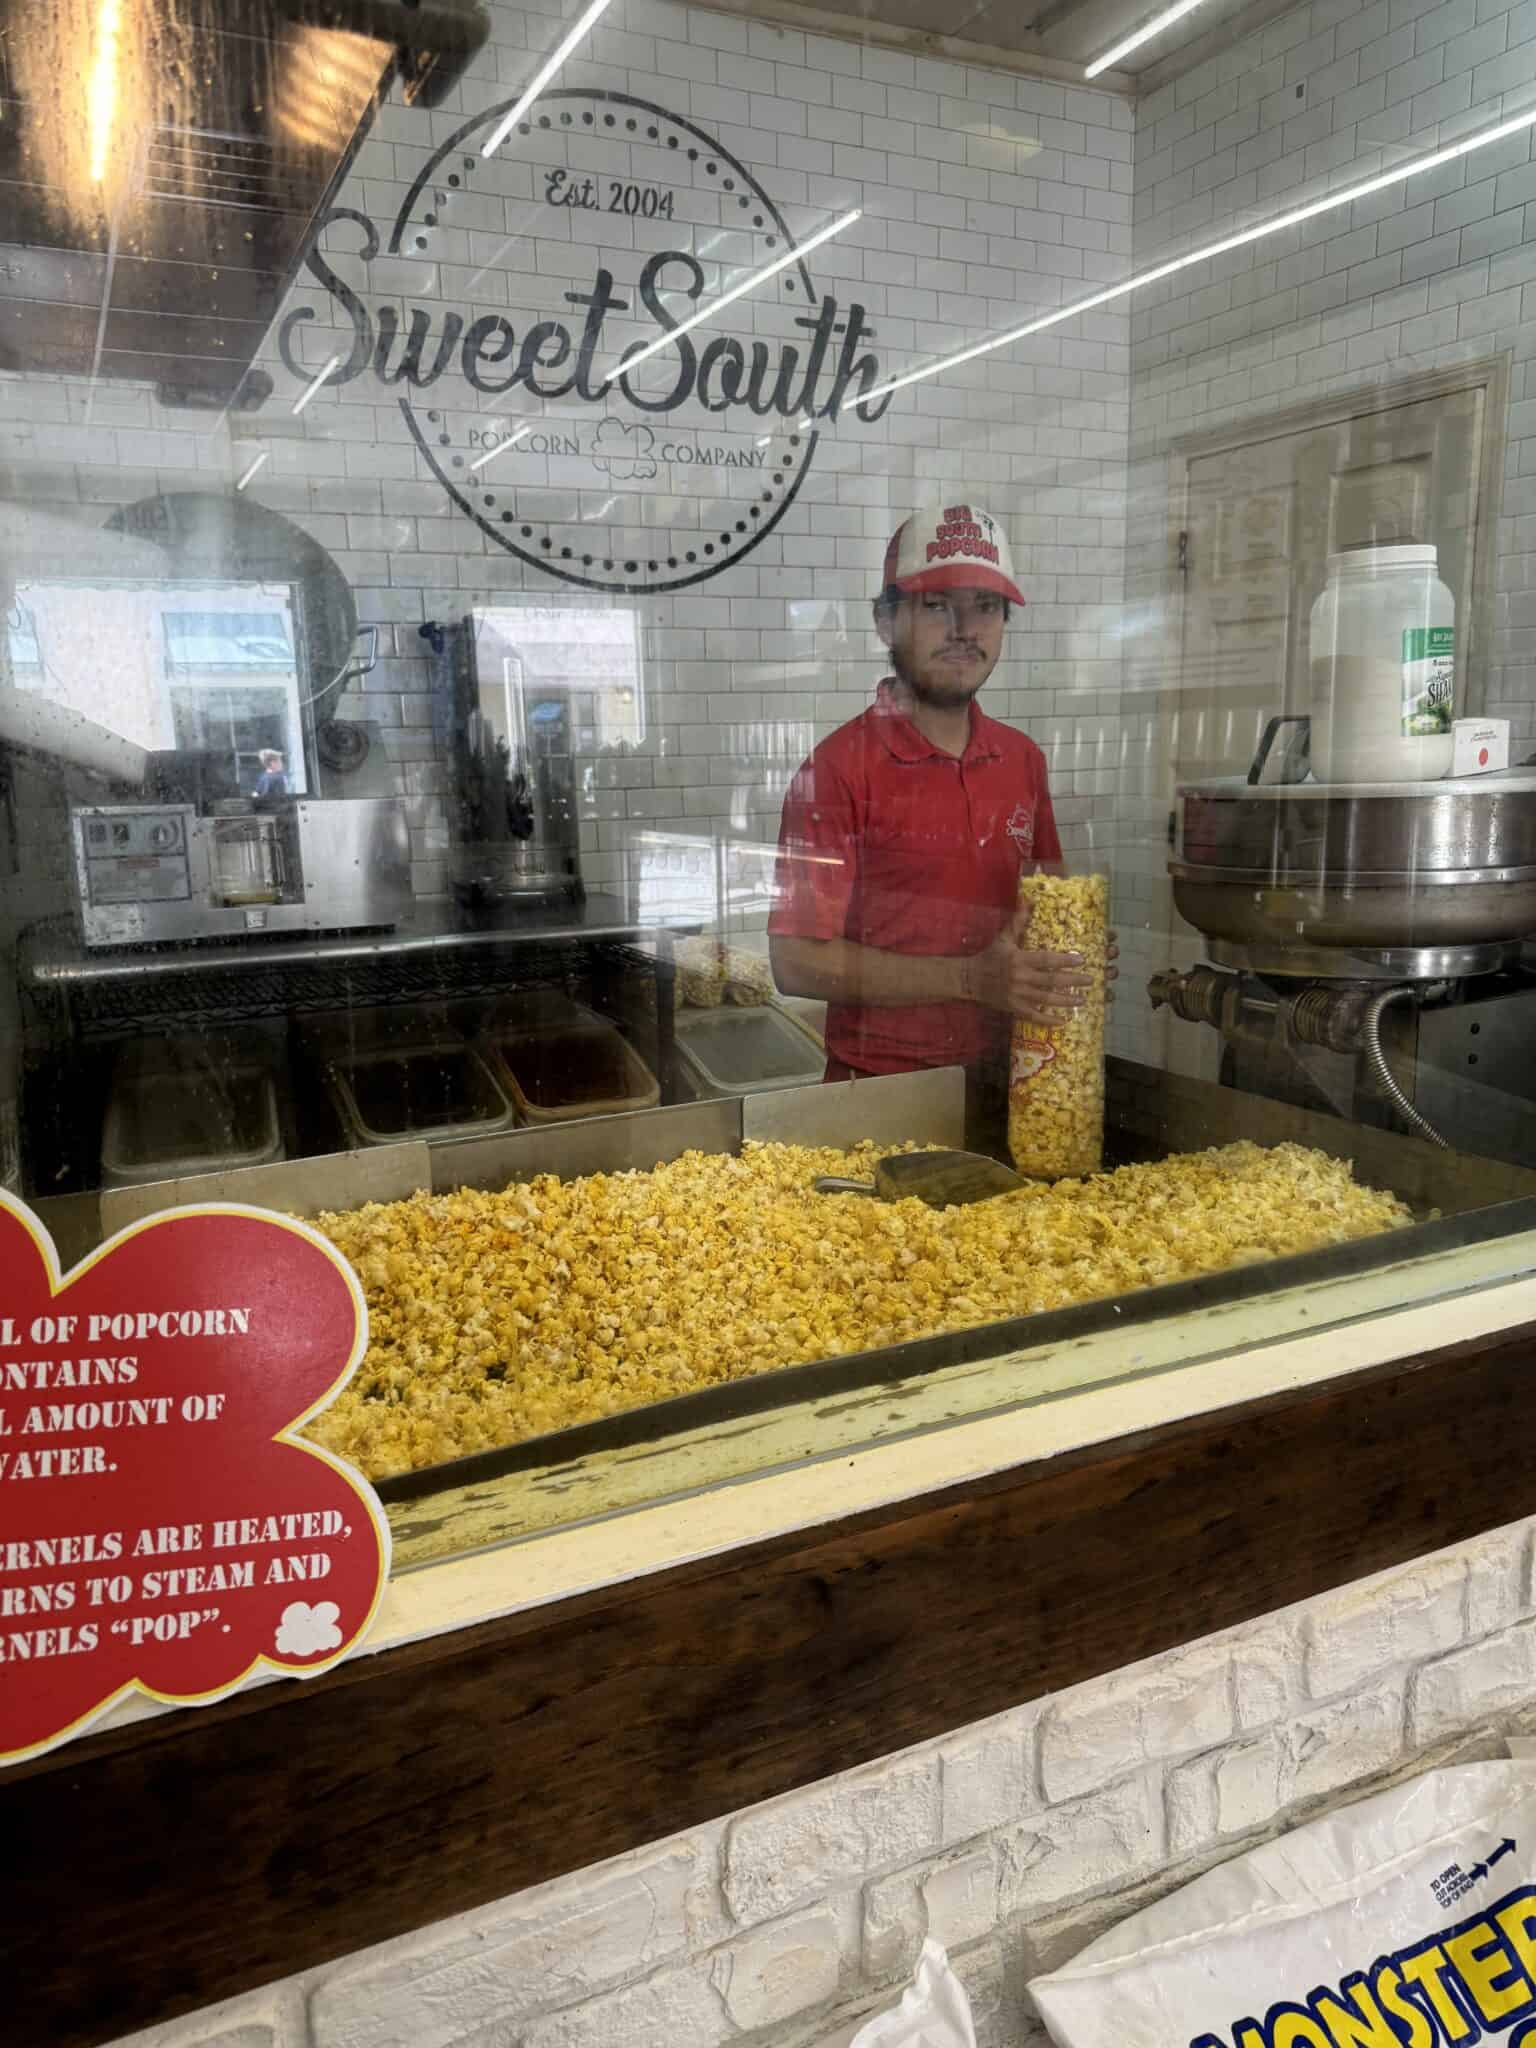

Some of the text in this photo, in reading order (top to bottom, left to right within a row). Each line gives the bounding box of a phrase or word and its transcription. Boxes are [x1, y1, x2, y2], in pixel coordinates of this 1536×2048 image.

[544, 169, 674, 220] Est. 2004
[661, 443, 766, 467] COMPANY
[30, 1316, 78, 1344] OF
[88, 1308, 252, 1342] POPCORN
[0, 1356, 139, 1391] NTAINS
[20, 1397, 174, 1435] AMOUNT
[182, 1394, 226, 1422] OF
[0, 1510, 353, 1573] RNELS ARE HEATED,
[0, 1552, 331, 1616] RNS TO STEAM AND
[1430, 1863, 1461, 1893] TO OPEN
[1190, 1886, 1536, 2048] ONSTER
